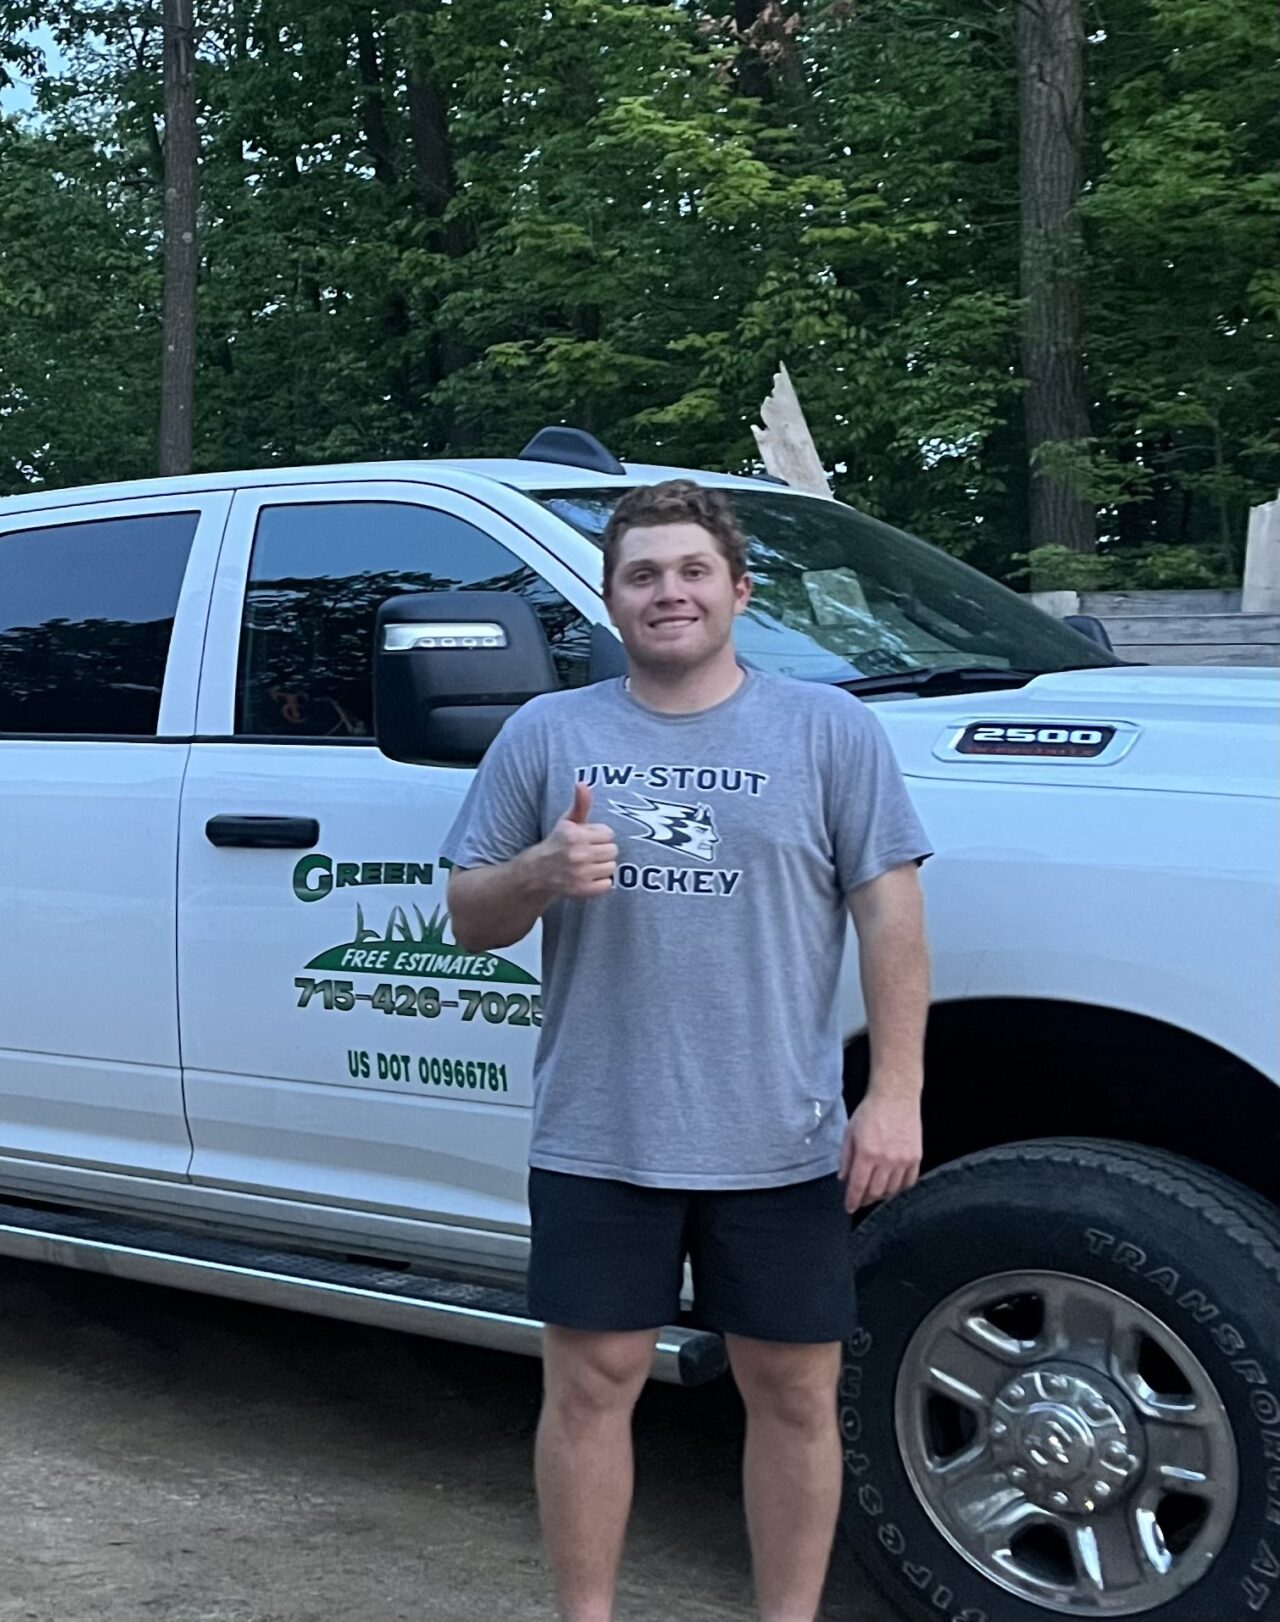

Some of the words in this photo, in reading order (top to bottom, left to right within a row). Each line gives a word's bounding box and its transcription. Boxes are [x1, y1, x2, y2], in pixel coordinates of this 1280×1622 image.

[973, 727, 1103, 744] 2500
[575, 764, 768, 796] UW-STOUT
[293, 853, 434, 902] GREEN
[611, 864, 741, 896] OCKEY
[340, 948, 392, 969] FREE
[393, 951, 499, 976] ESTIMATES
[347, 1050, 371, 1079] US
[377, 1053, 411, 1083] DOT
[419, 1056, 508, 1091] 00966781
[1240, 1539, 1280, 1611] AT
